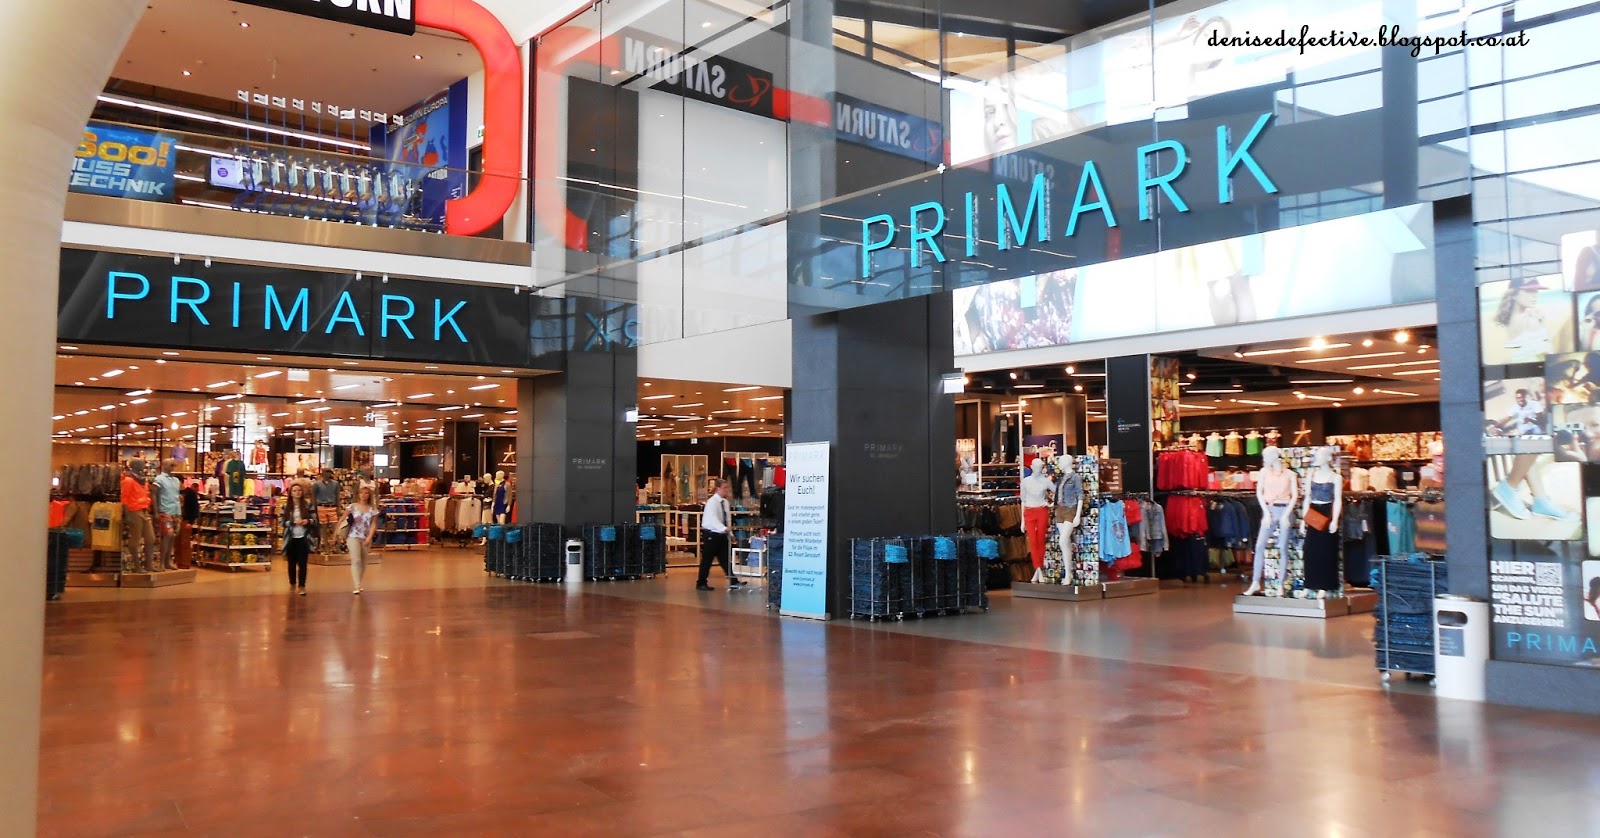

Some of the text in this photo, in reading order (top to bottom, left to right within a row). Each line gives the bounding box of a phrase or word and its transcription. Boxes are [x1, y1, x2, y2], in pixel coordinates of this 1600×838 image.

[69, 171, 166, 196] ECHNIK
[861, 112, 1279, 279] PRIMARK
[106, 270, 469, 343] PRIMARK
[789, 473, 825, 483] Wir suchen
[797, 485, 815, 495] Euch!
[1490, 560, 1535, 575] HIER
[1509, 584, 1530, 594] DAS
[1530, 586, 1563, 596] VIDEO
[1492, 603, 1523, 617] THE
[1506, 631, 1597, 654] PRIMA
